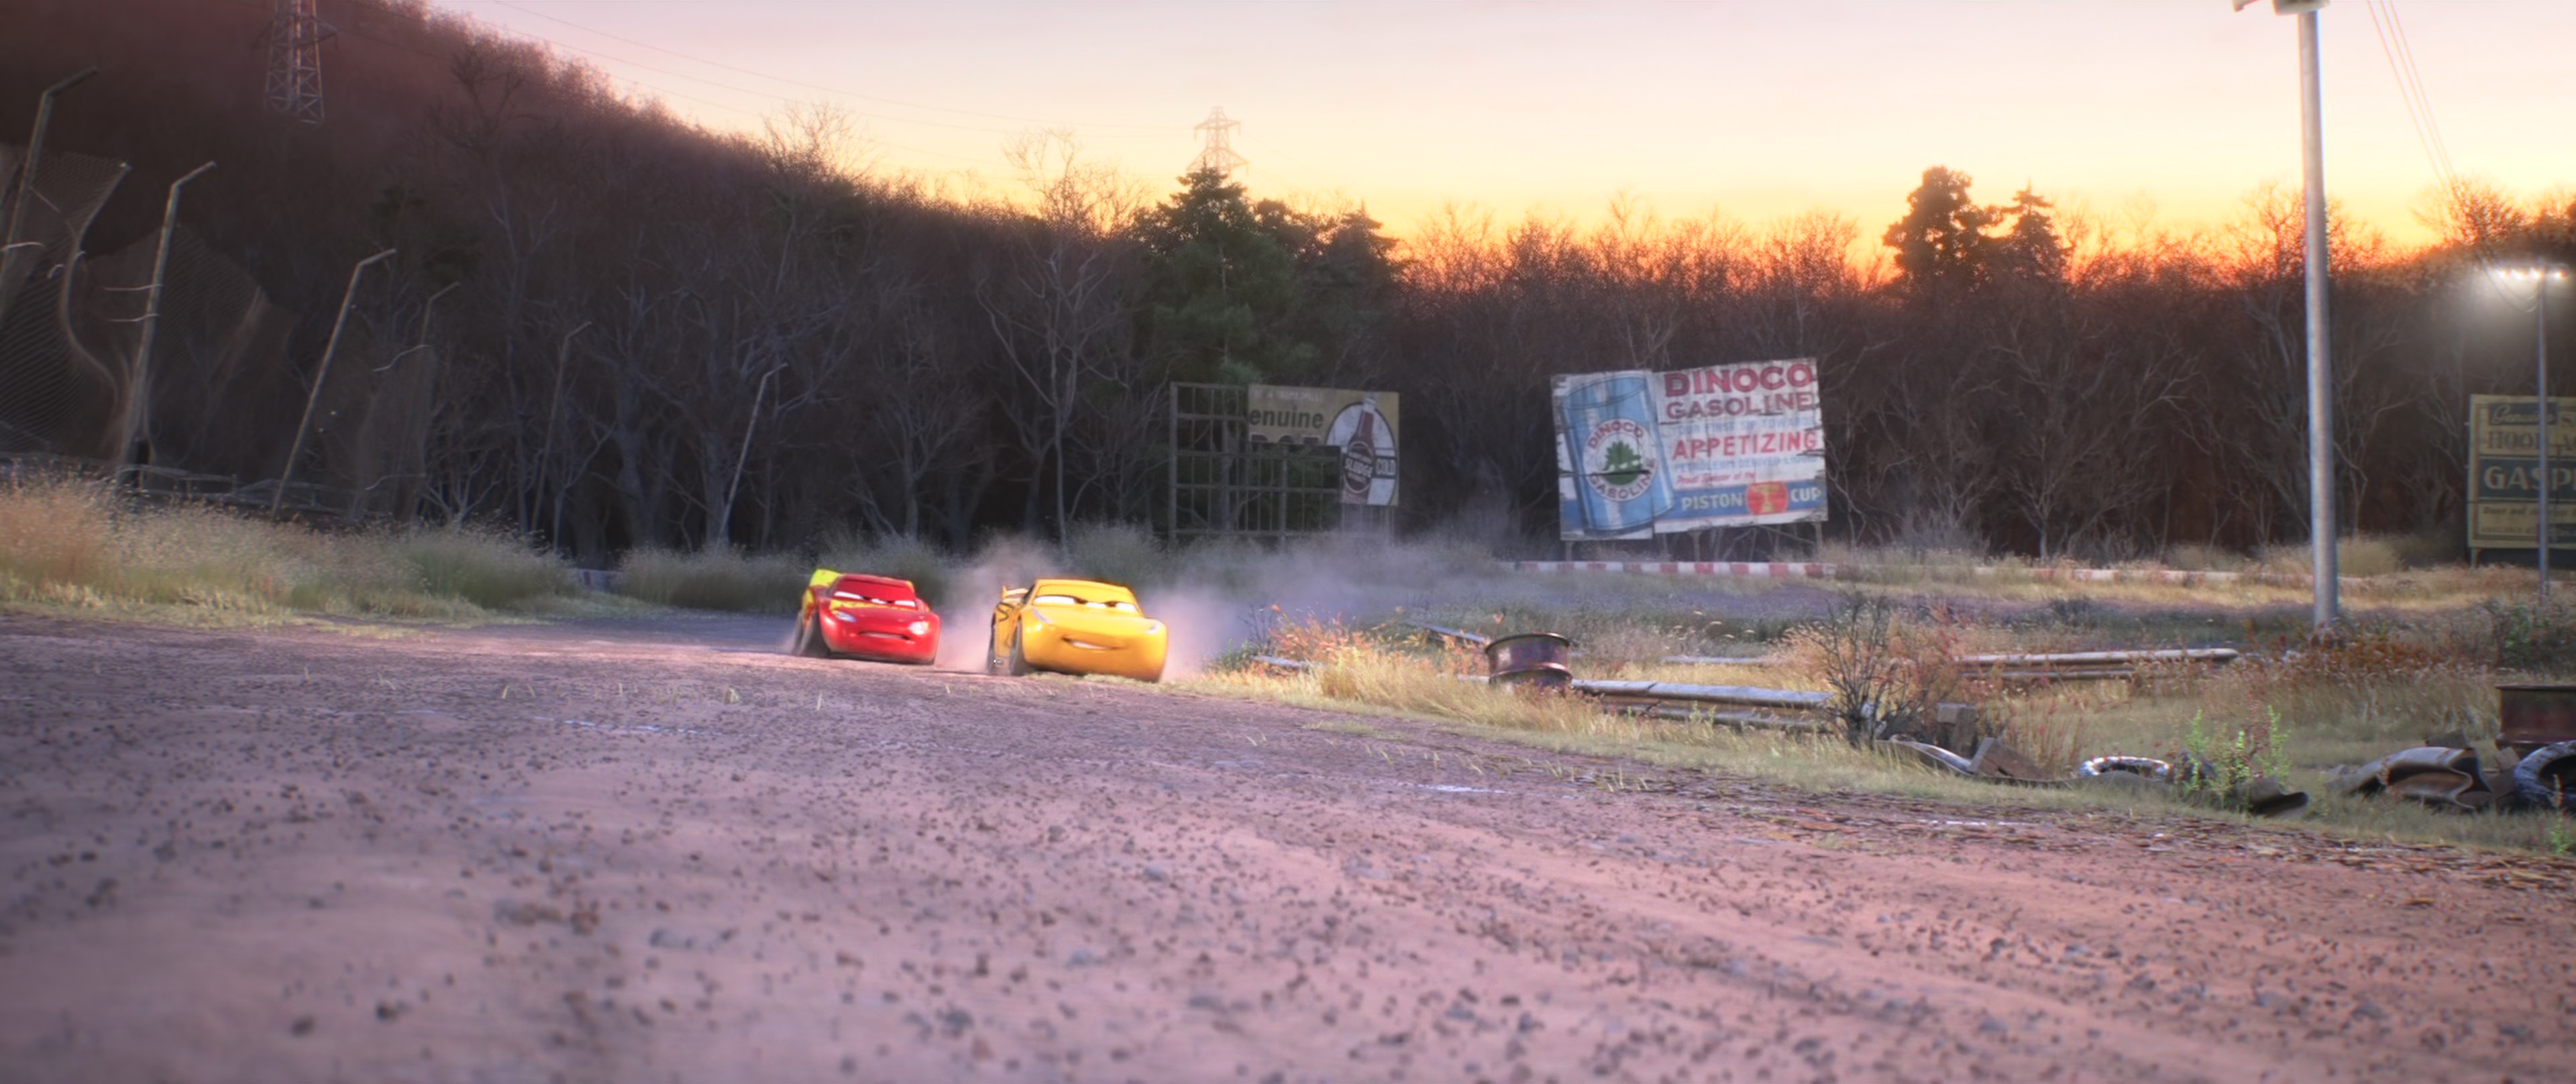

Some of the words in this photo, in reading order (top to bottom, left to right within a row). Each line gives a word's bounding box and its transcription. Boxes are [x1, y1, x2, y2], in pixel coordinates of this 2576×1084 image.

[1664, 364, 1813, 397] DINOCO
[1666, 391, 1813, 419] GASOLINE
[1588, 421, 1644, 449] DINOCO
[1672, 431, 1817, 460] APPETIZING
[1590, 457, 1655, 498] GASOLINE
[2483, 466, 2576, 491] GASP
[1682, 492, 1743, 511] PISTON
[1790, 487, 1822, 502] CUP
